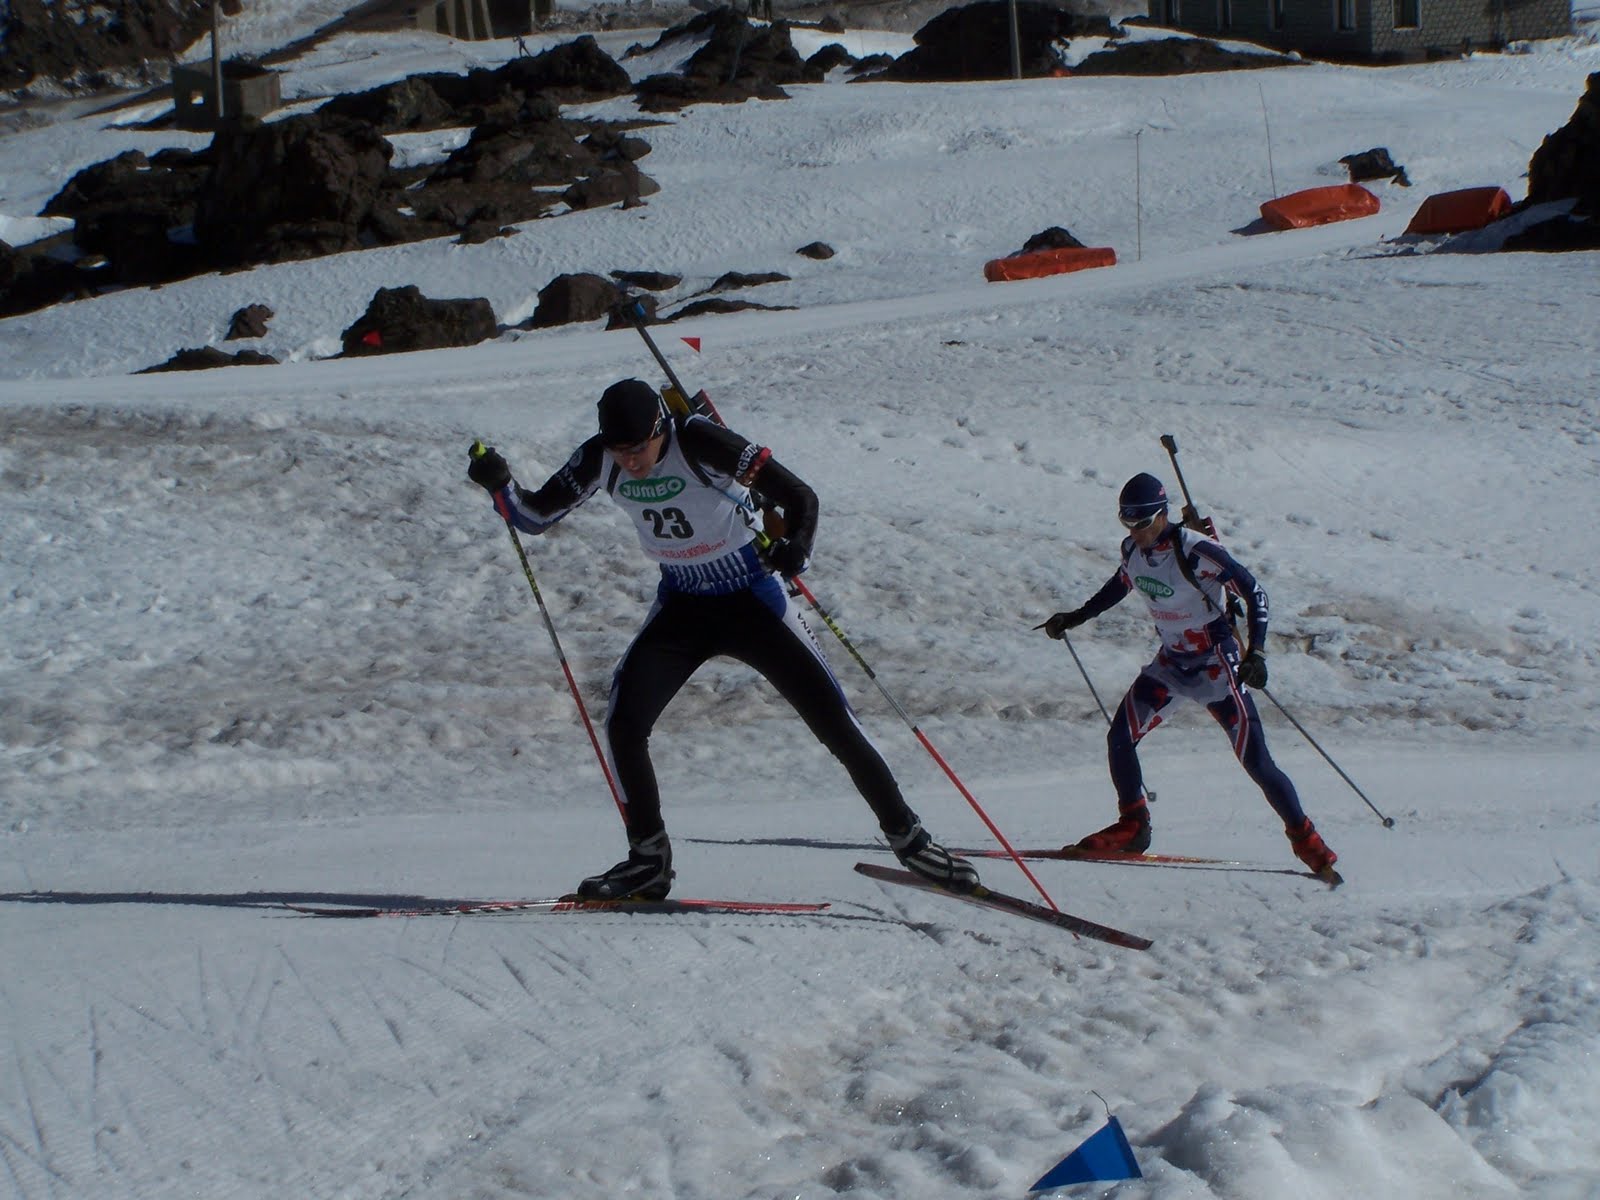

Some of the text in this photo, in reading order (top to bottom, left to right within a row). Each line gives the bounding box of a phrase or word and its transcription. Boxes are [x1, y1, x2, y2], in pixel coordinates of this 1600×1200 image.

[622, 478, 682, 498] JUMBO
[641, 506, 694, 539] 23
[1137, 578, 1172, 596] JUMBO
